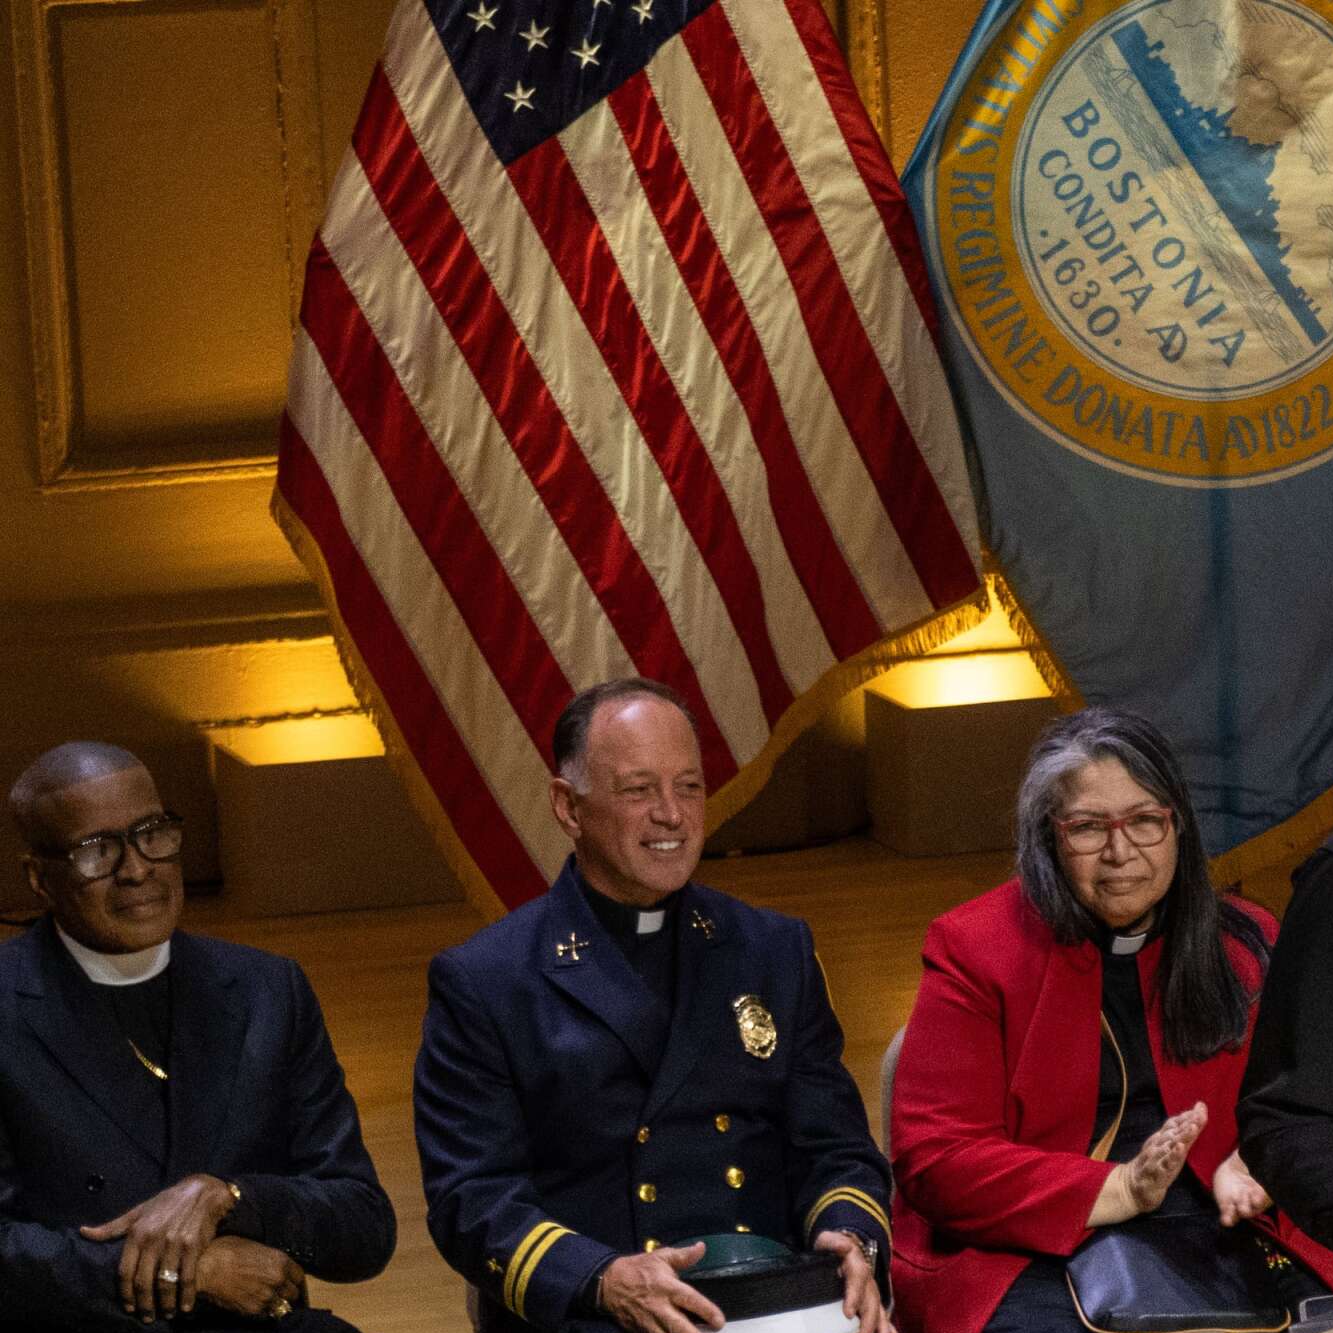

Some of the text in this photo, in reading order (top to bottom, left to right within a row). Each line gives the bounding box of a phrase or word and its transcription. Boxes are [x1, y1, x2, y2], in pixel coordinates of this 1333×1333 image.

[958, 0, 1082, 163] IVITATIS
[951, 170, 1057, 384] REGIMINE
[1038, 149, 1154, 314] CONDITA
[1062, 100, 1246, 368] BOSTONIA
[1044, 364, 1209, 462] DONATA
